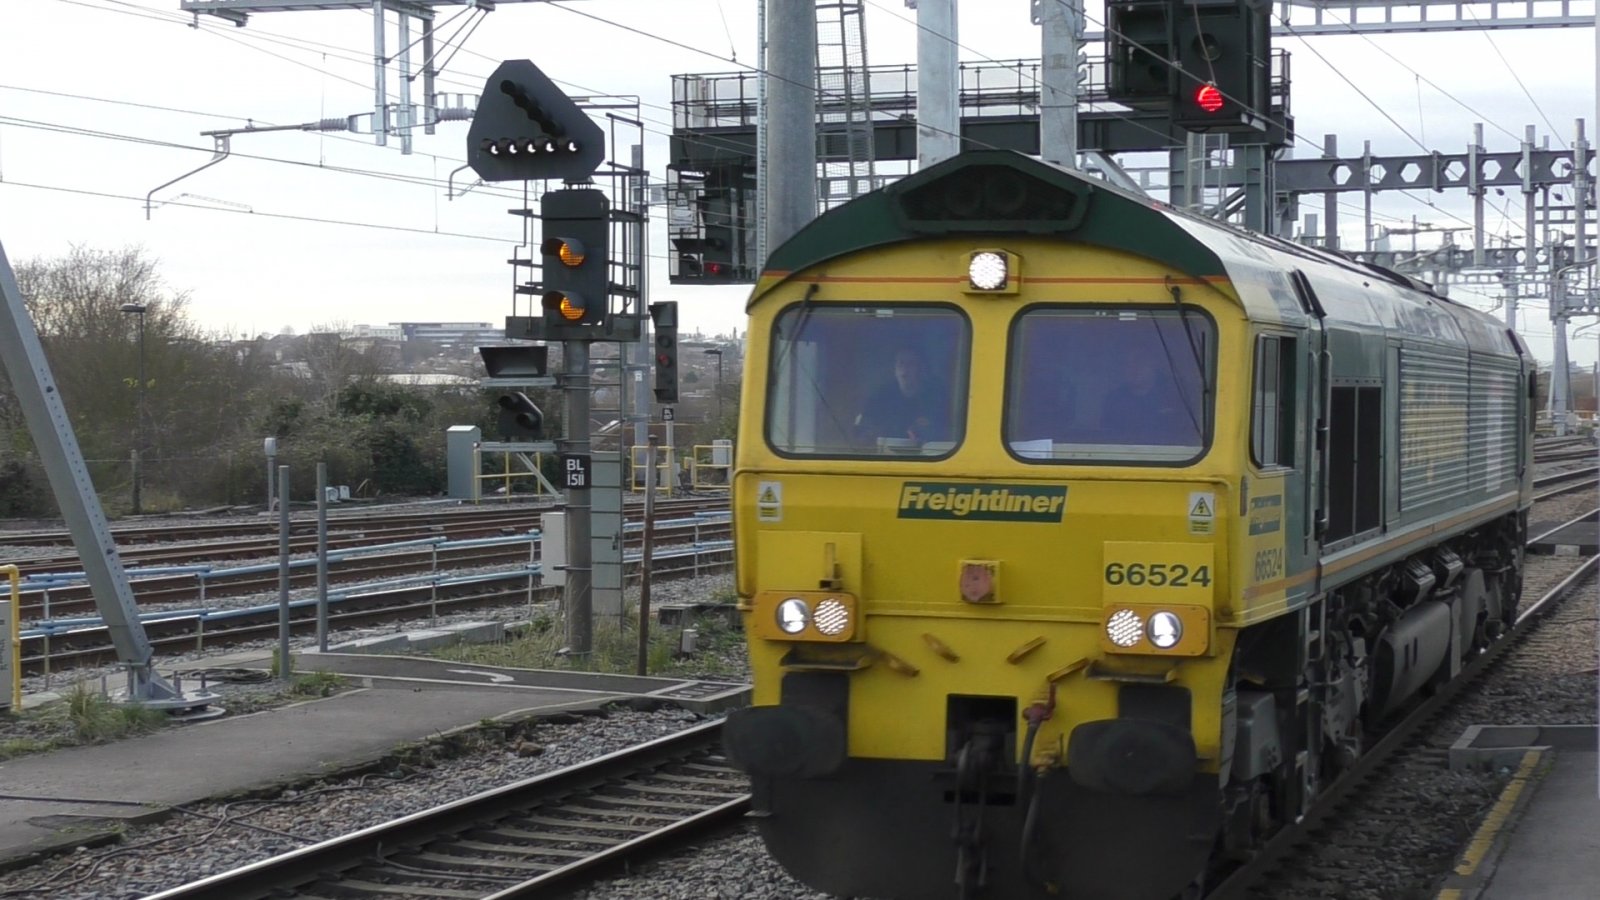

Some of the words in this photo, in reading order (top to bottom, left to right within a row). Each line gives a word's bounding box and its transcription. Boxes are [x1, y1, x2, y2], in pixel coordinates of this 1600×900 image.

[566, 459, 585, 471] BL
[900, 486, 1065, 516] Freightliner
[1105, 563, 1211, 587] 66524
